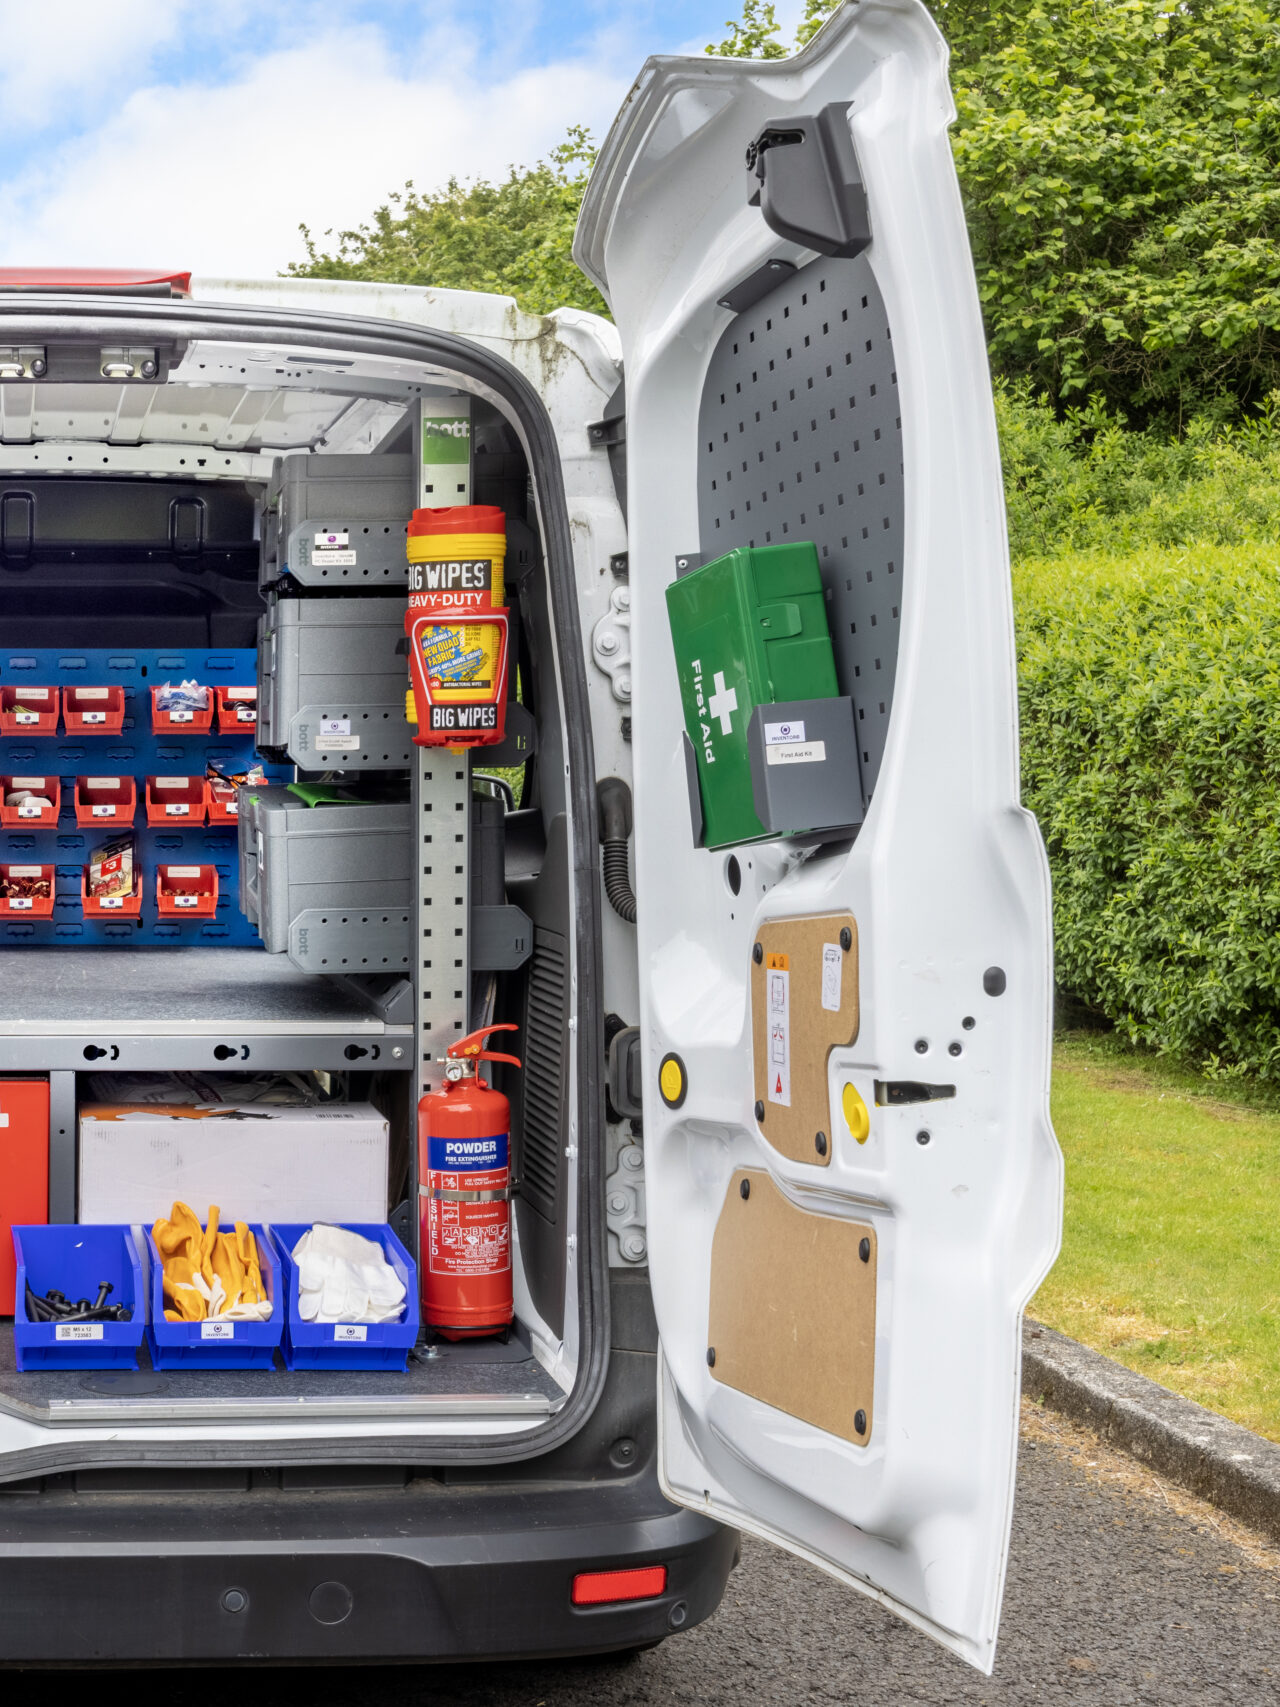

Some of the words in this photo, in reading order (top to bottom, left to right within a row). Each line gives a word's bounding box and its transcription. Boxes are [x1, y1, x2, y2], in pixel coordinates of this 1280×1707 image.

[299, 538, 309, 567] bott
[425, 562, 485, 589] WIPES
[437, 636, 460, 653] QUAD
[427, 649, 455, 668] FABRIC
[432, 707, 455, 728] BIG
[457, 706, 495, 727] WIPES
[691, 659, 708, 717] First
[700, 723, 716, 764] Aid
[299, 724, 309, 752] bott
[298, 928, 309, 956] bott
[446, 1140, 497, 1154] POWDER
[457, 1154, 497, 1162] EXTINGUISHER
[430, 1171, 439, 1256] FIESHIELD
